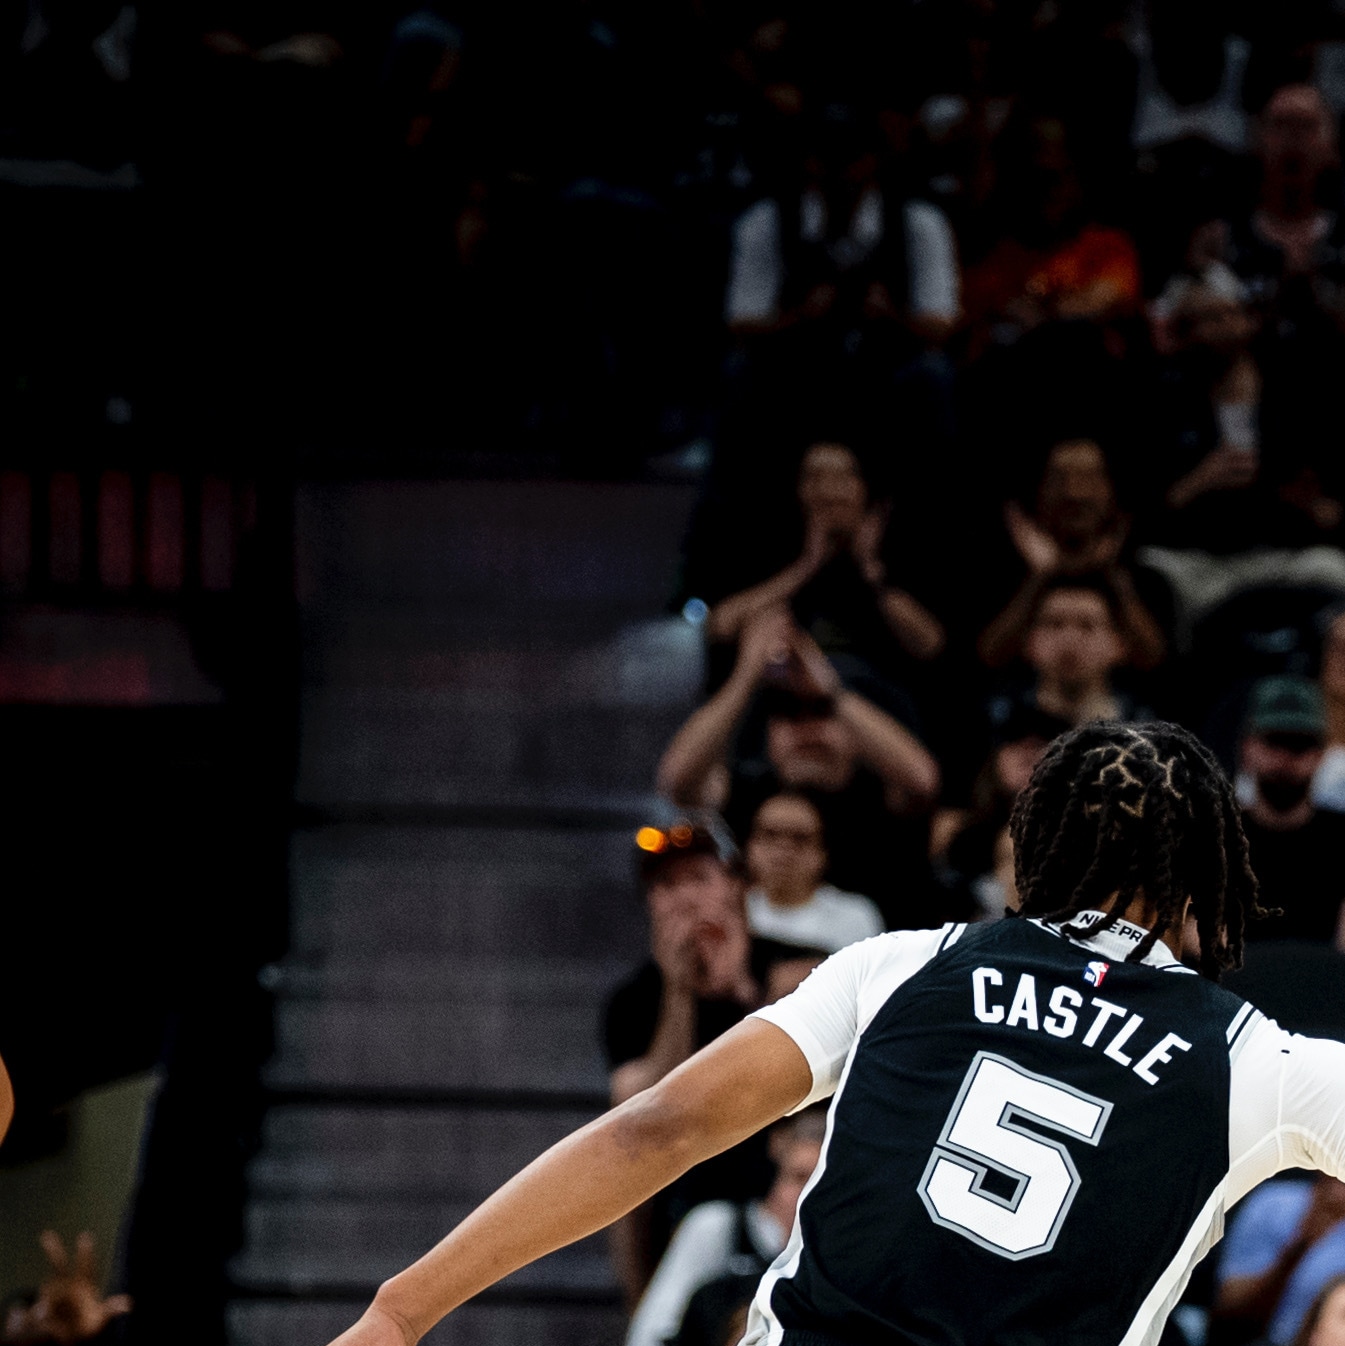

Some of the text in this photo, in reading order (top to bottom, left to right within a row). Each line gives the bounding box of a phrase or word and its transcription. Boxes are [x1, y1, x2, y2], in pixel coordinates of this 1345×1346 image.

[1117, 925, 1144, 944] PR
[972, 966, 1193, 1086] CASTLE
[915, 1050, 1115, 1262] 5
